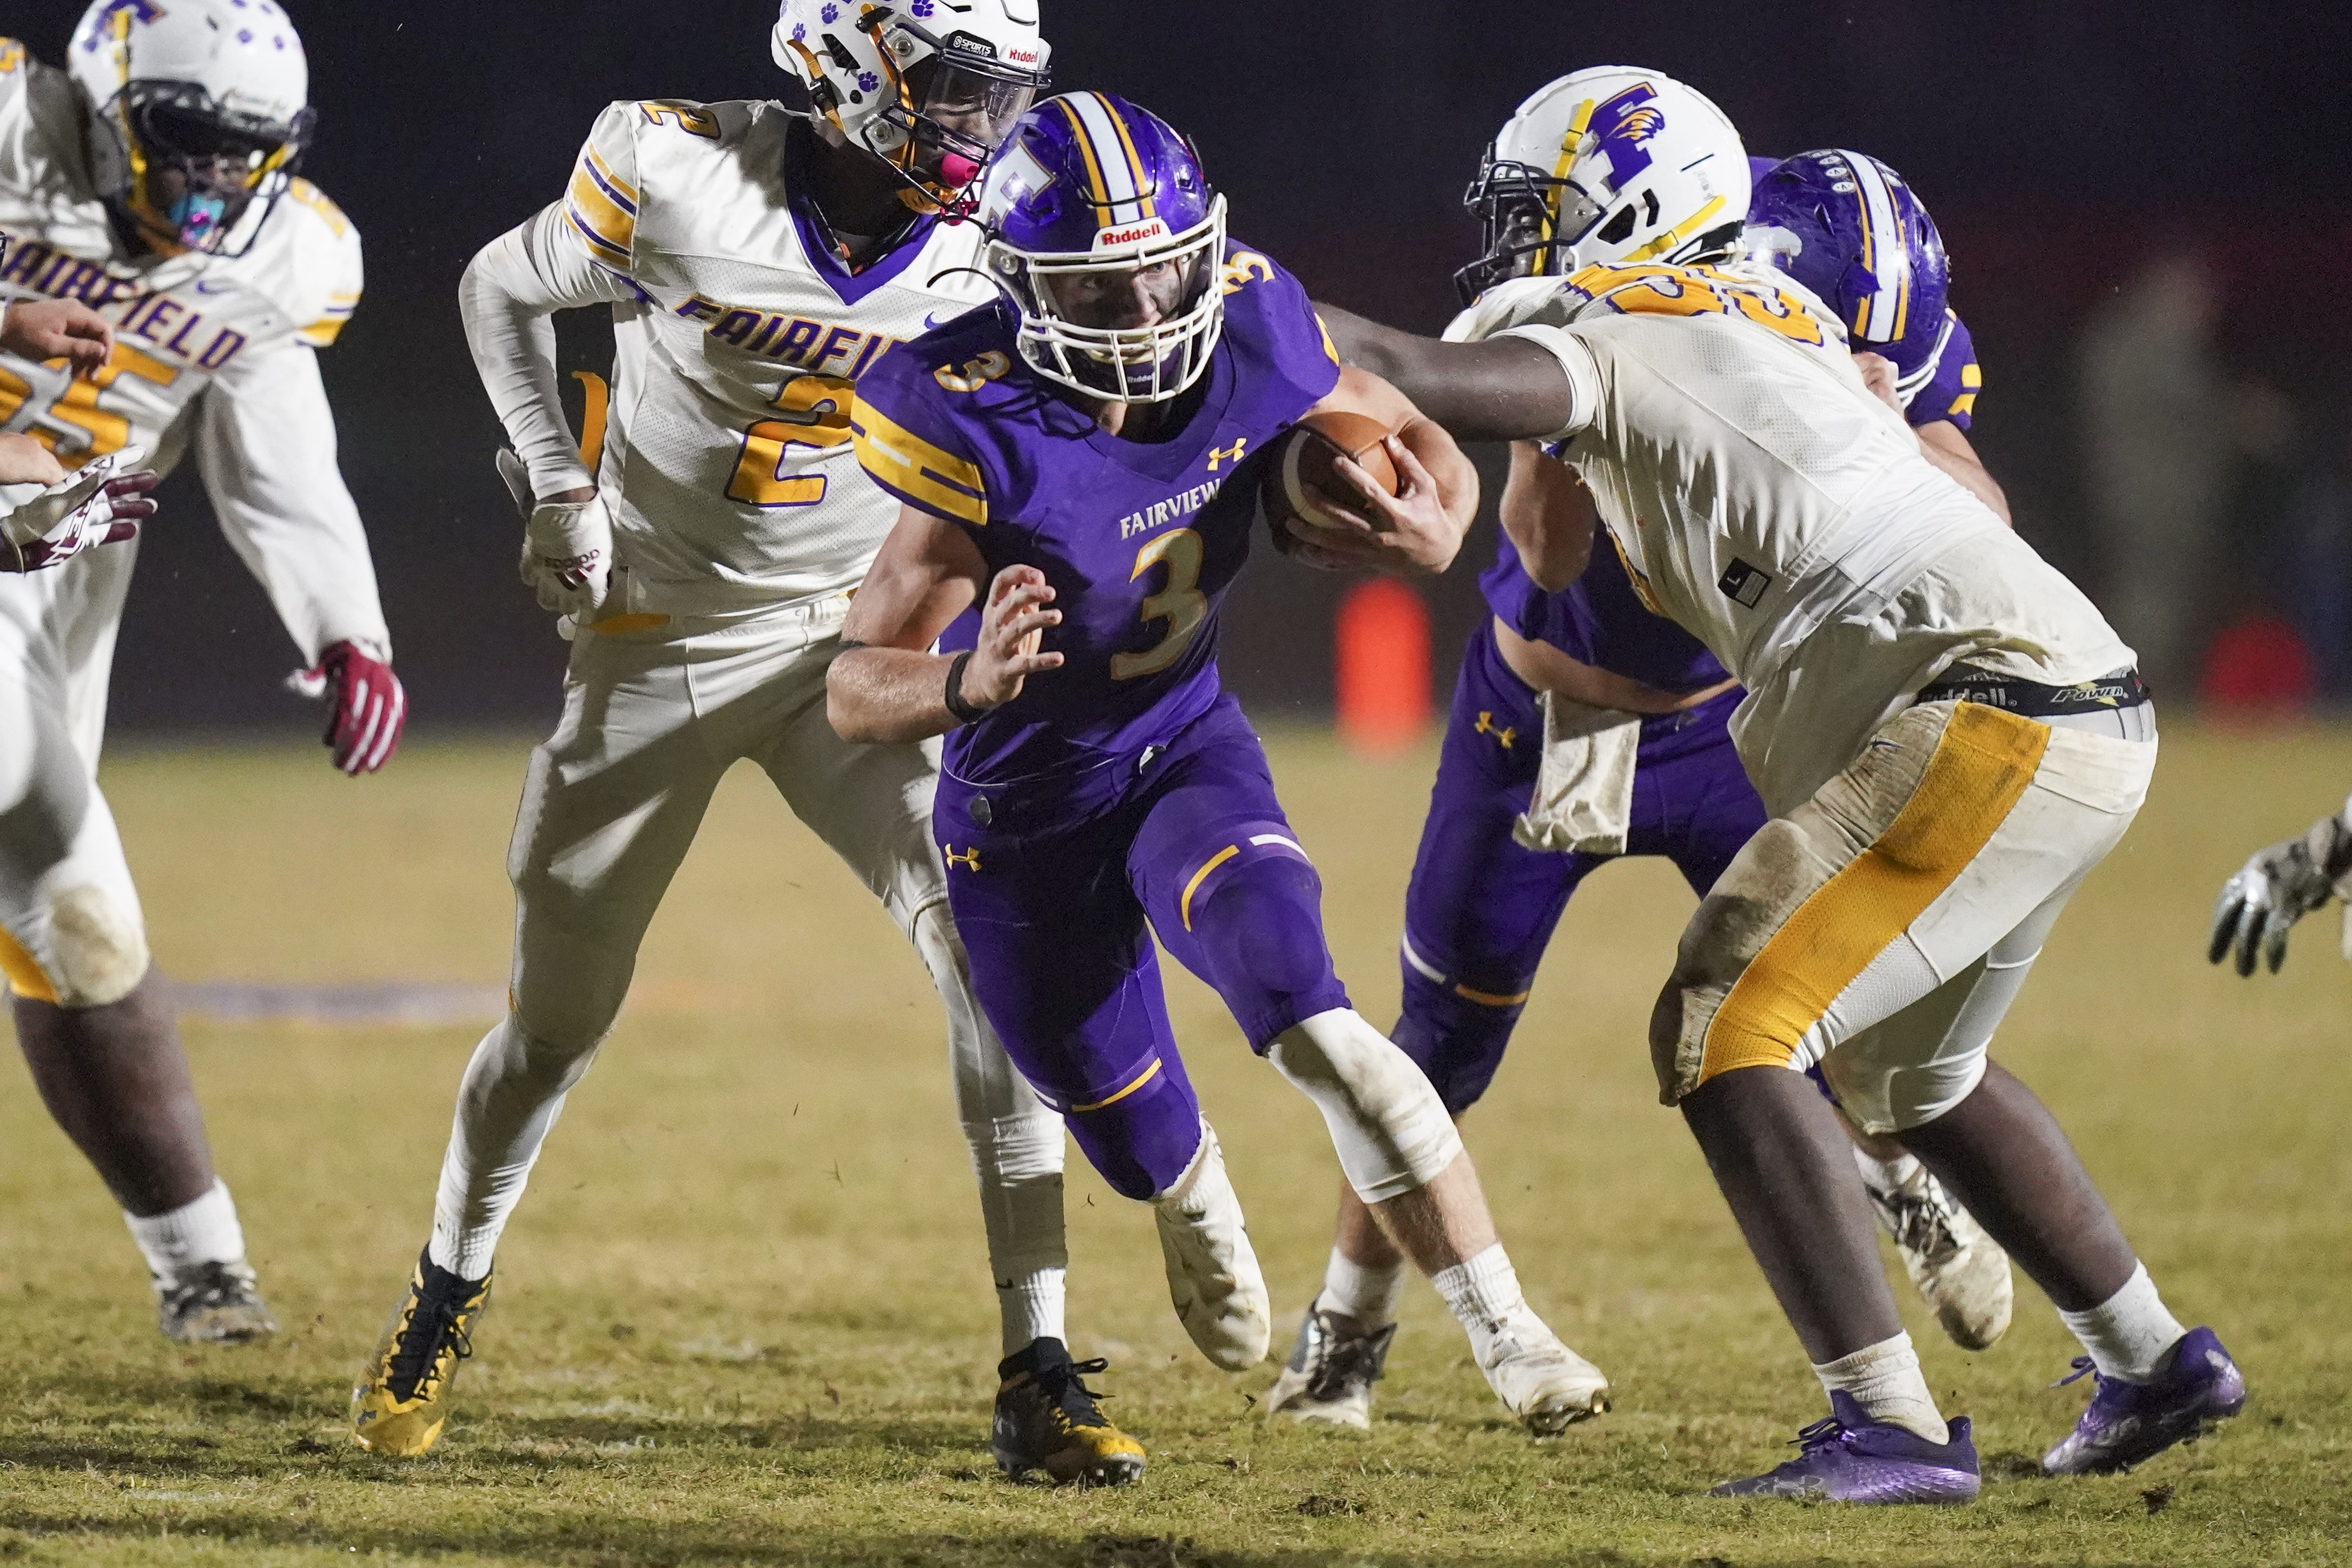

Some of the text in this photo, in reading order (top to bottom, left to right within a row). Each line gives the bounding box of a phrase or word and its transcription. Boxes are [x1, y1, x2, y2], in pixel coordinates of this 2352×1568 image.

[961, 38, 992, 54] SPORTS
[1101, 224, 1160, 246] Riddell
[0, 233, 246, 370] AIRFIELD
[674, 292, 909, 379] FAIRFI
[934, 350, 1011, 393] 3
[724, 373, 857, 507] 2
[1120, 478, 1221, 540] FAIRVIEW
[1111, 527, 1208, 680] 3
